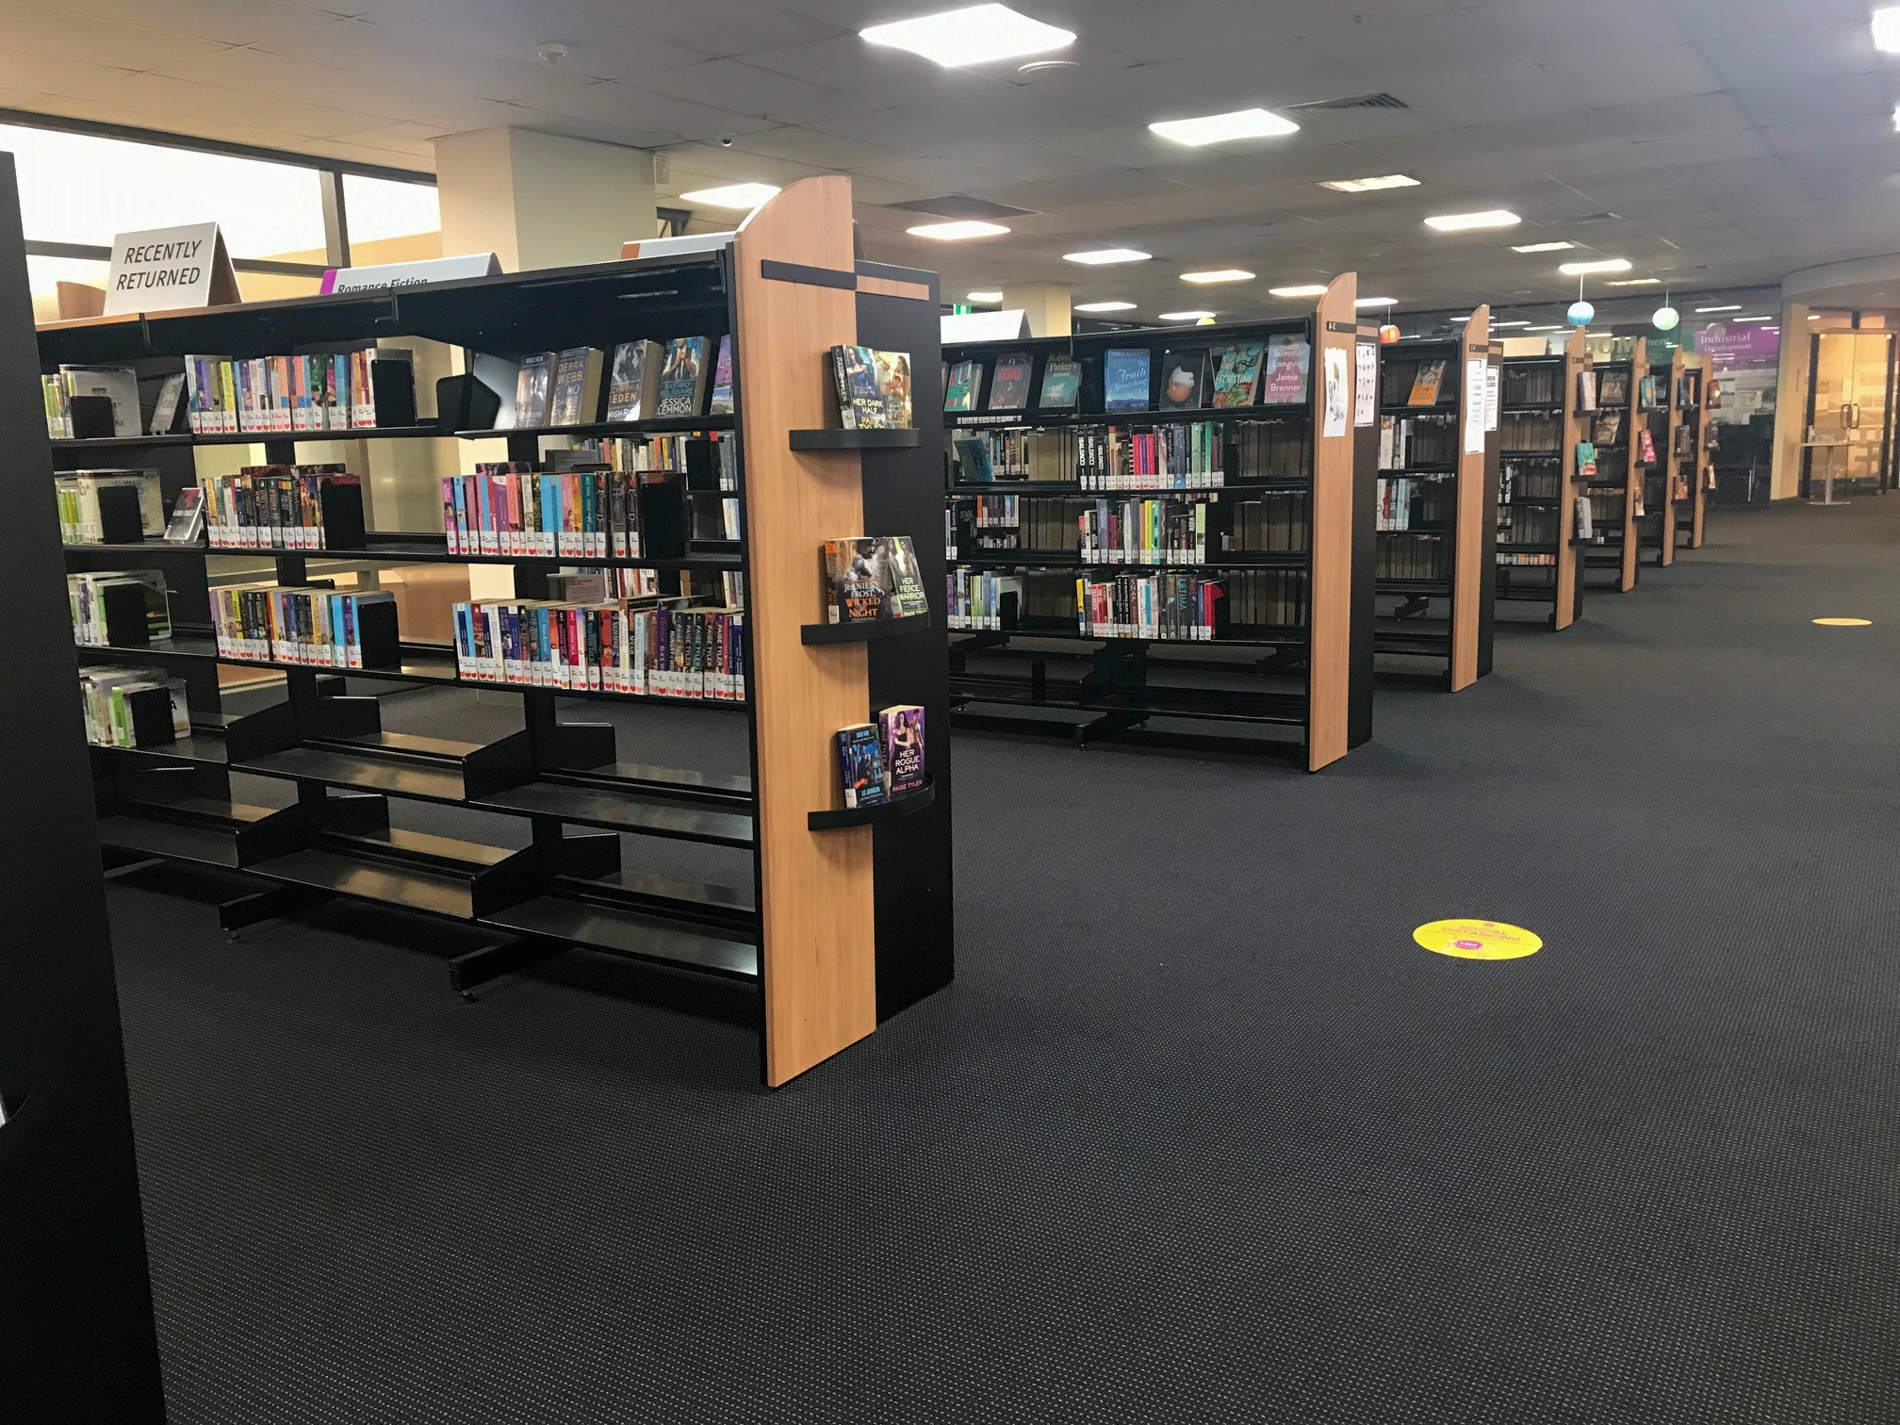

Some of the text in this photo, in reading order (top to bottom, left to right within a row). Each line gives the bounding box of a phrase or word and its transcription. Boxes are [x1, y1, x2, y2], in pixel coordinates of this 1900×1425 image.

[124, 240, 203, 264] RECENTLY
[116, 267, 201, 291] RETURNED
[1700, 331, 1751, 344] Industrial
[558, 360, 584, 373] DEBRA
[557, 371, 583, 384] WEBB
[1118, 367, 1147, 381] Truth
[1275, 373, 1299, 382] Jamie
[566, 384, 580, 395] NO
[1270, 383, 1302, 392] Brenner
[612, 391, 637, 404] EDEN
[659, 396, 691, 407] JESSICA
[853, 398, 884, 408] HER DARK
[608, 410, 623, 419] HIGH
[657, 404, 692, 416] LEMMON
[861, 406, 877, 415] HALF
[850, 588, 874, 598] FROST
[899, 592, 925, 600] WARRIOR
[1178, 578, 1187, 611] ULTIMA
[845, 597, 881, 608] WICKED
[849, 608, 878, 618] NIGHT
[899, 748, 915, 759] HER
[895, 755, 920, 768] ROGUE
[895, 764, 919, 776] ALPHA
[892, 783, 907, 793] PAIGE
[907, 780, 923, 789] TYLER
